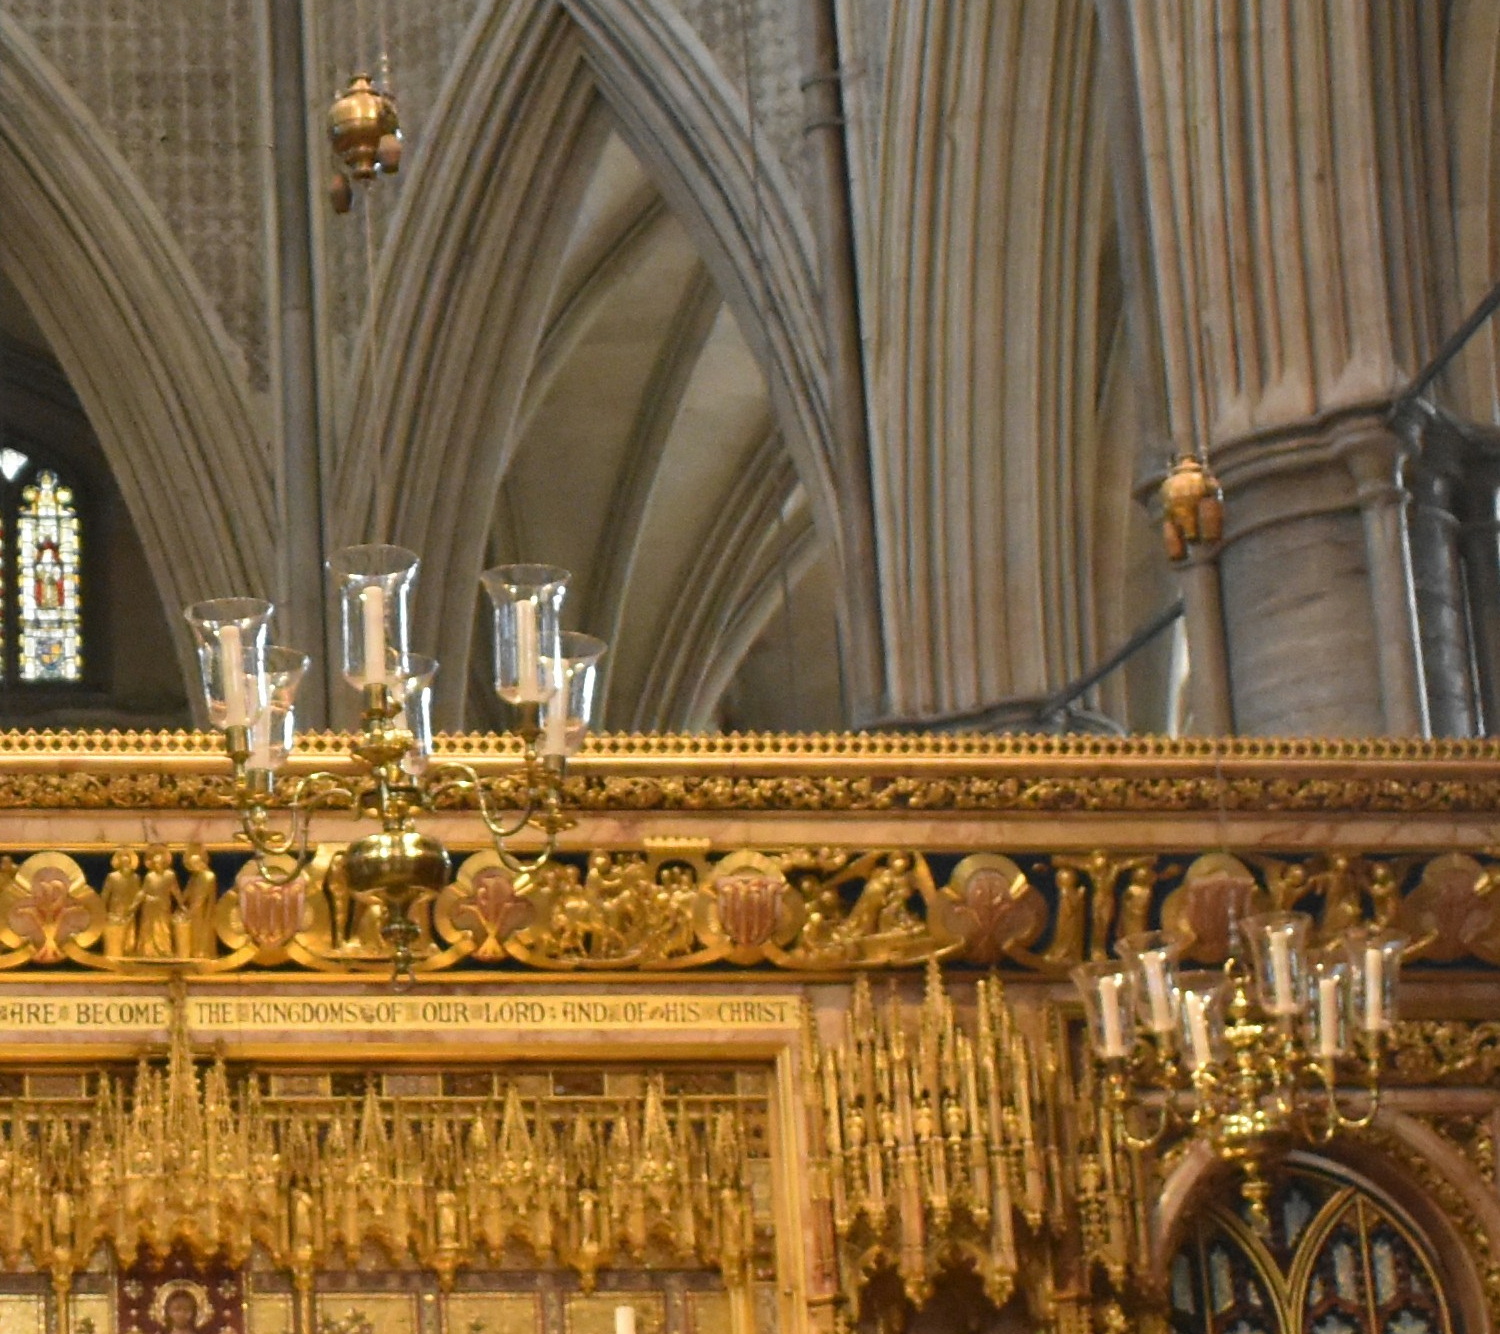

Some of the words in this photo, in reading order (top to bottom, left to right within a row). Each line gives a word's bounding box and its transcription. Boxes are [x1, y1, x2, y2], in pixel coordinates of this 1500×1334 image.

[10, 1001, 57, 1024] ARE
[76, 1001, 166, 1024] BECOME
[195, 1001, 234, 1024] THE
[252, 1001, 361, 1024] KINGDOMS
[376, 1001, 403, 1024] OF
[422, 1001, 470, 1024] OUR
[562, 1001, 609, 1024] AND
[623, 1001, 649, 1024] OF
[664, 1001, 701, 1024] HIS
